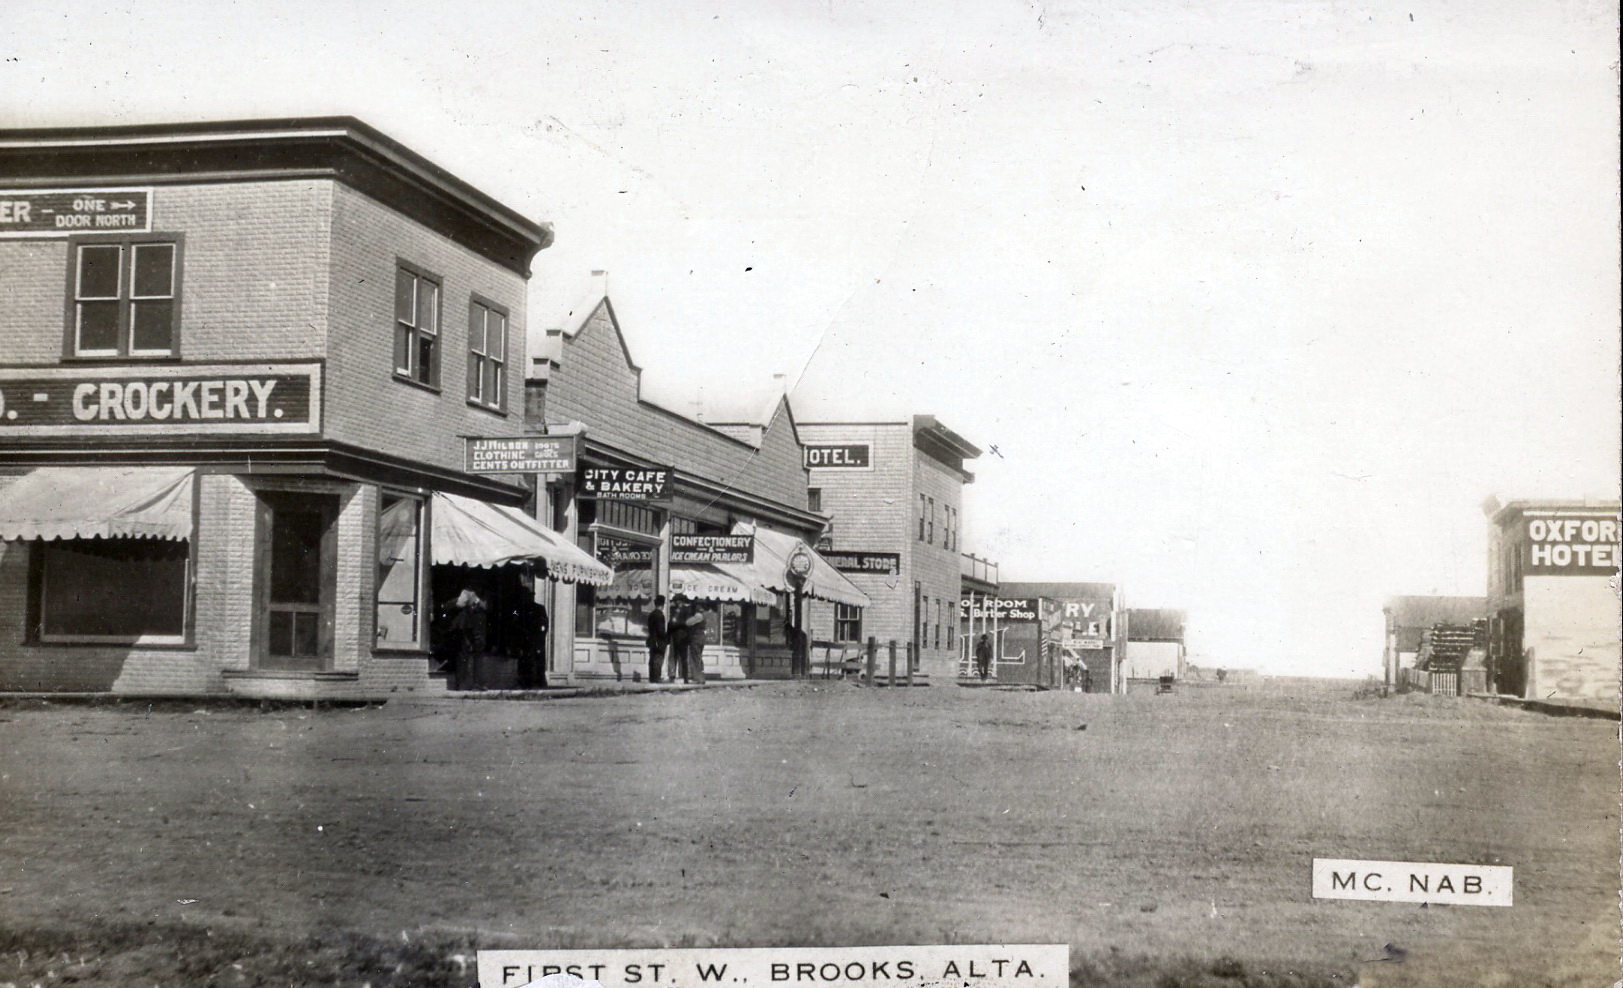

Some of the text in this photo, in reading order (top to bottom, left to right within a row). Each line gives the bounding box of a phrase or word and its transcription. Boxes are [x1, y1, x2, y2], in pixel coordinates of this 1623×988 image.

[73, 199, 106, 211] ONE
[55, 214, 136, 227] DOOR NORTH
[72, 380, 284, 420] CROCKERY.
[473, 451, 525, 460] CLOTHING
[805, 449, 860, 464] OTEL.
[510, 459, 569, 469] OUTFITTER
[585, 469, 666, 483] CITY CAFE
[585, 481, 663, 493] & BAKERY
[1529, 520, 1620, 542] OXFOR
[673, 536, 751, 548] CONFECTIONERY
[671, 552, 748, 562] ICE CREAM PARLORS
[823, 556, 897, 570] NERAL STORE
[707, 585, 738, 593] CREAM
[984, 600, 1027, 608] ROOM
[1009, 609, 1035, 619] Shop
[1062, 603, 1095, 618] RY
